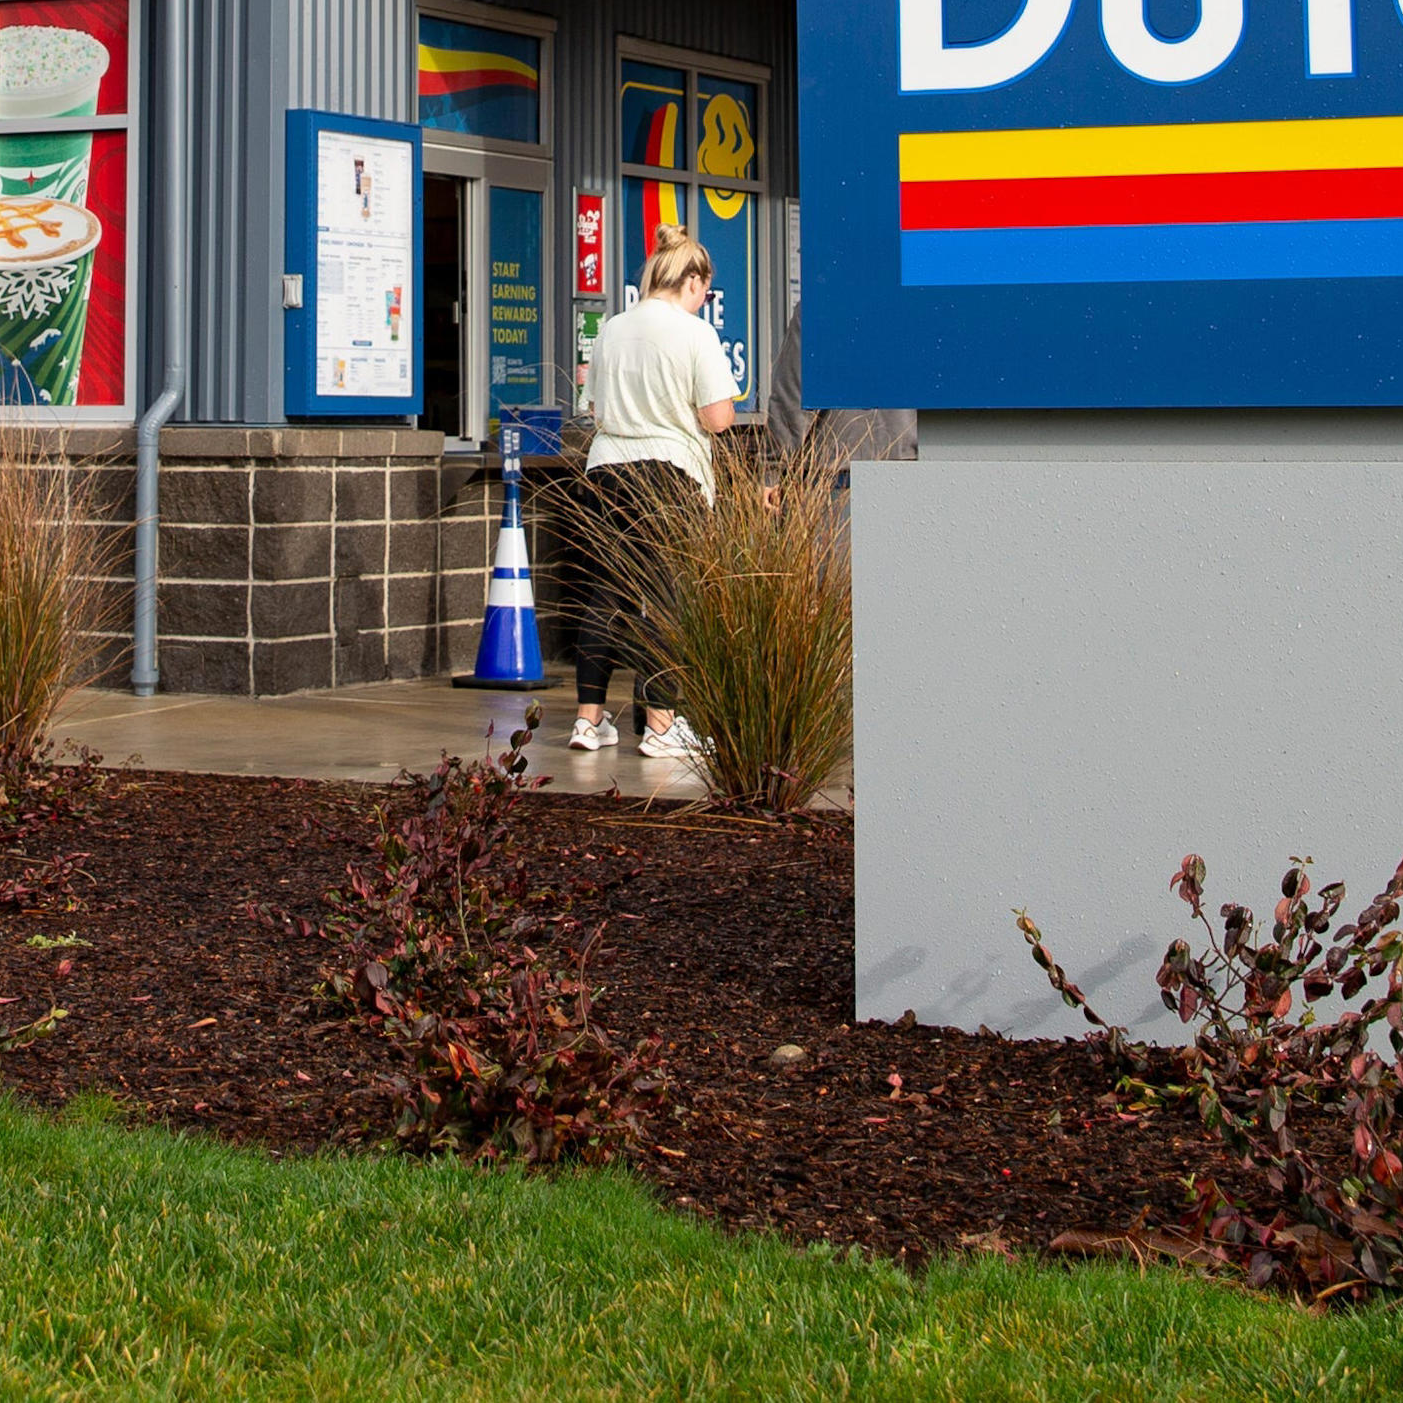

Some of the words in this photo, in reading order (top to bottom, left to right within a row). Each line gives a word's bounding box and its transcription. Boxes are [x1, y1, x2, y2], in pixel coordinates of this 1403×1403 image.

[492, 261, 520, 278] START
[492, 284, 536, 301] EARNING
[492, 306, 538, 322] REWARDS
[492, 328, 528, 344] TODAY!
